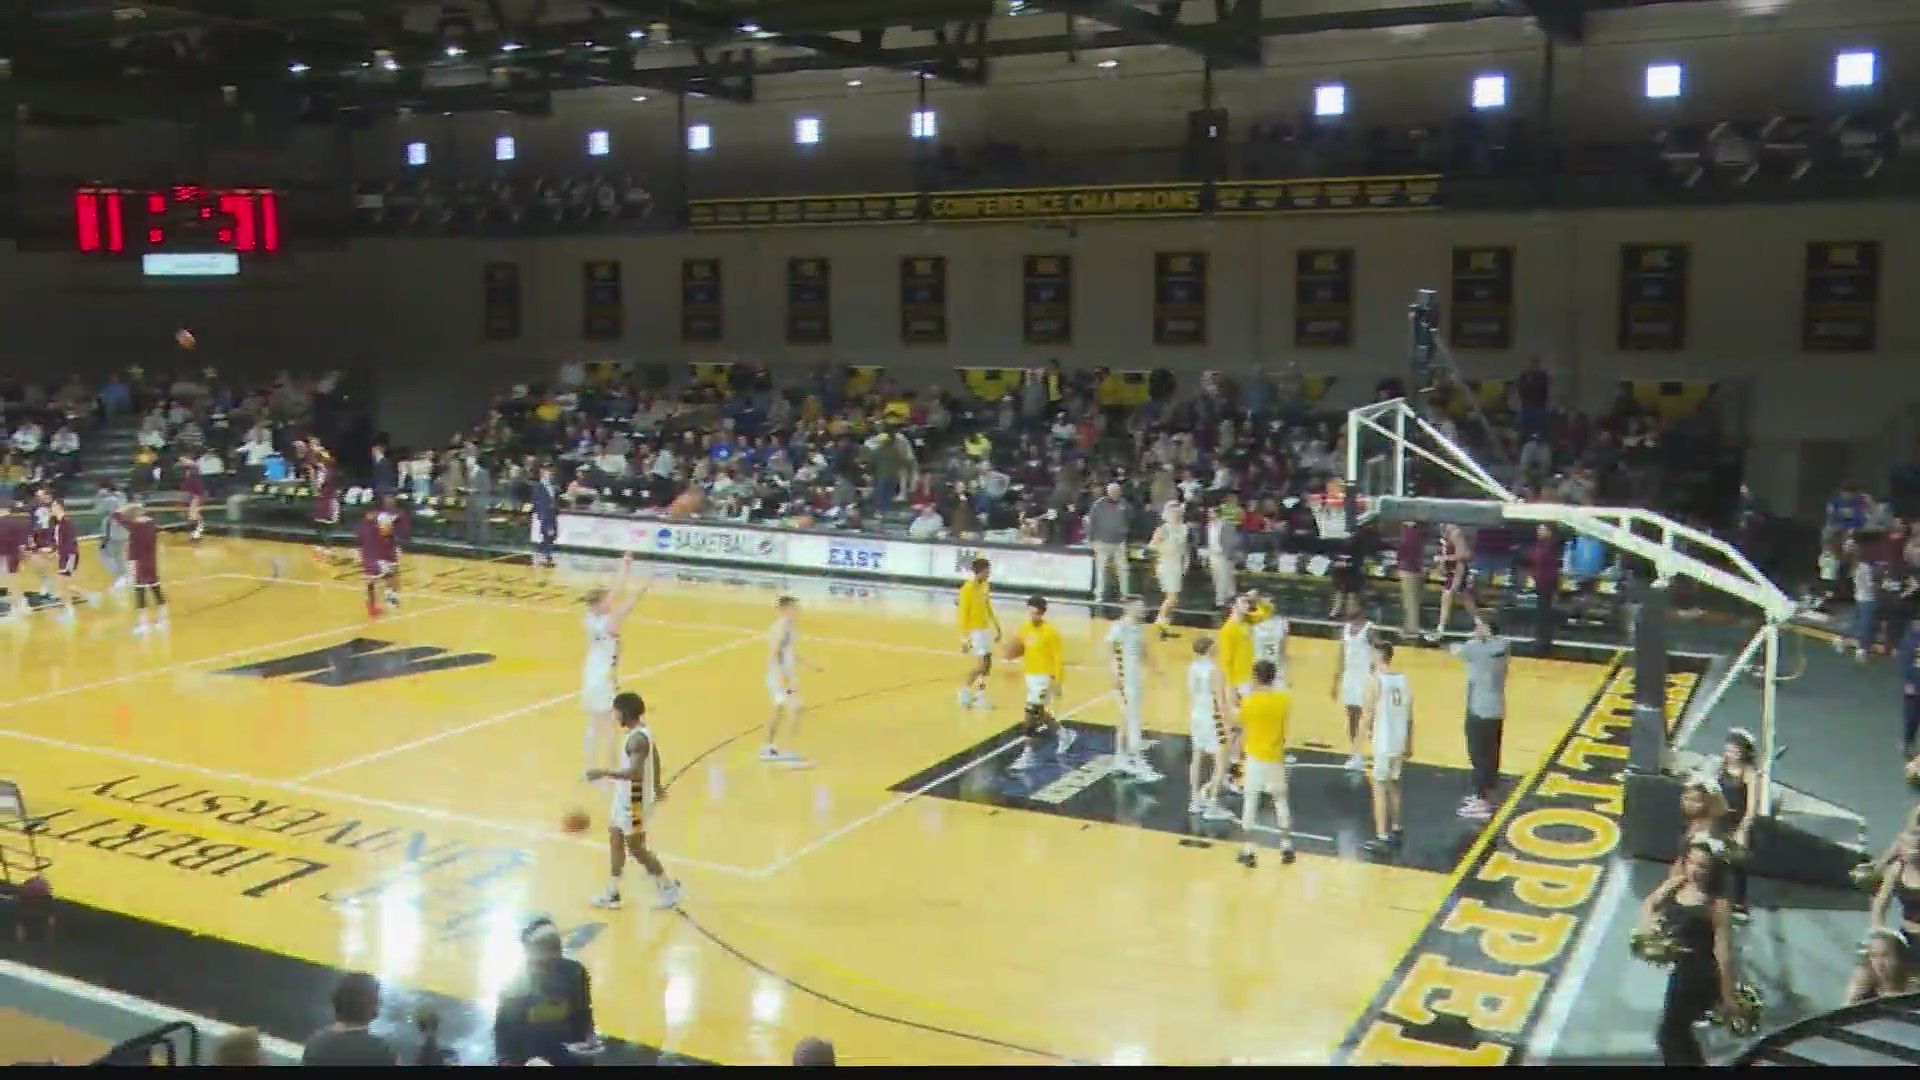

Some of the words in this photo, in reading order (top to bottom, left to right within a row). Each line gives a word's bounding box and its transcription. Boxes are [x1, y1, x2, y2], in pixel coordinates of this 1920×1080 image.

[931, 193, 1066, 217] CONFERENCE
[1069, 190, 1201, 213] CHAMPIONS
[828, 546, 888, 569] EAST
[1350, 665, 1699, 1066] HILLTOPPE
